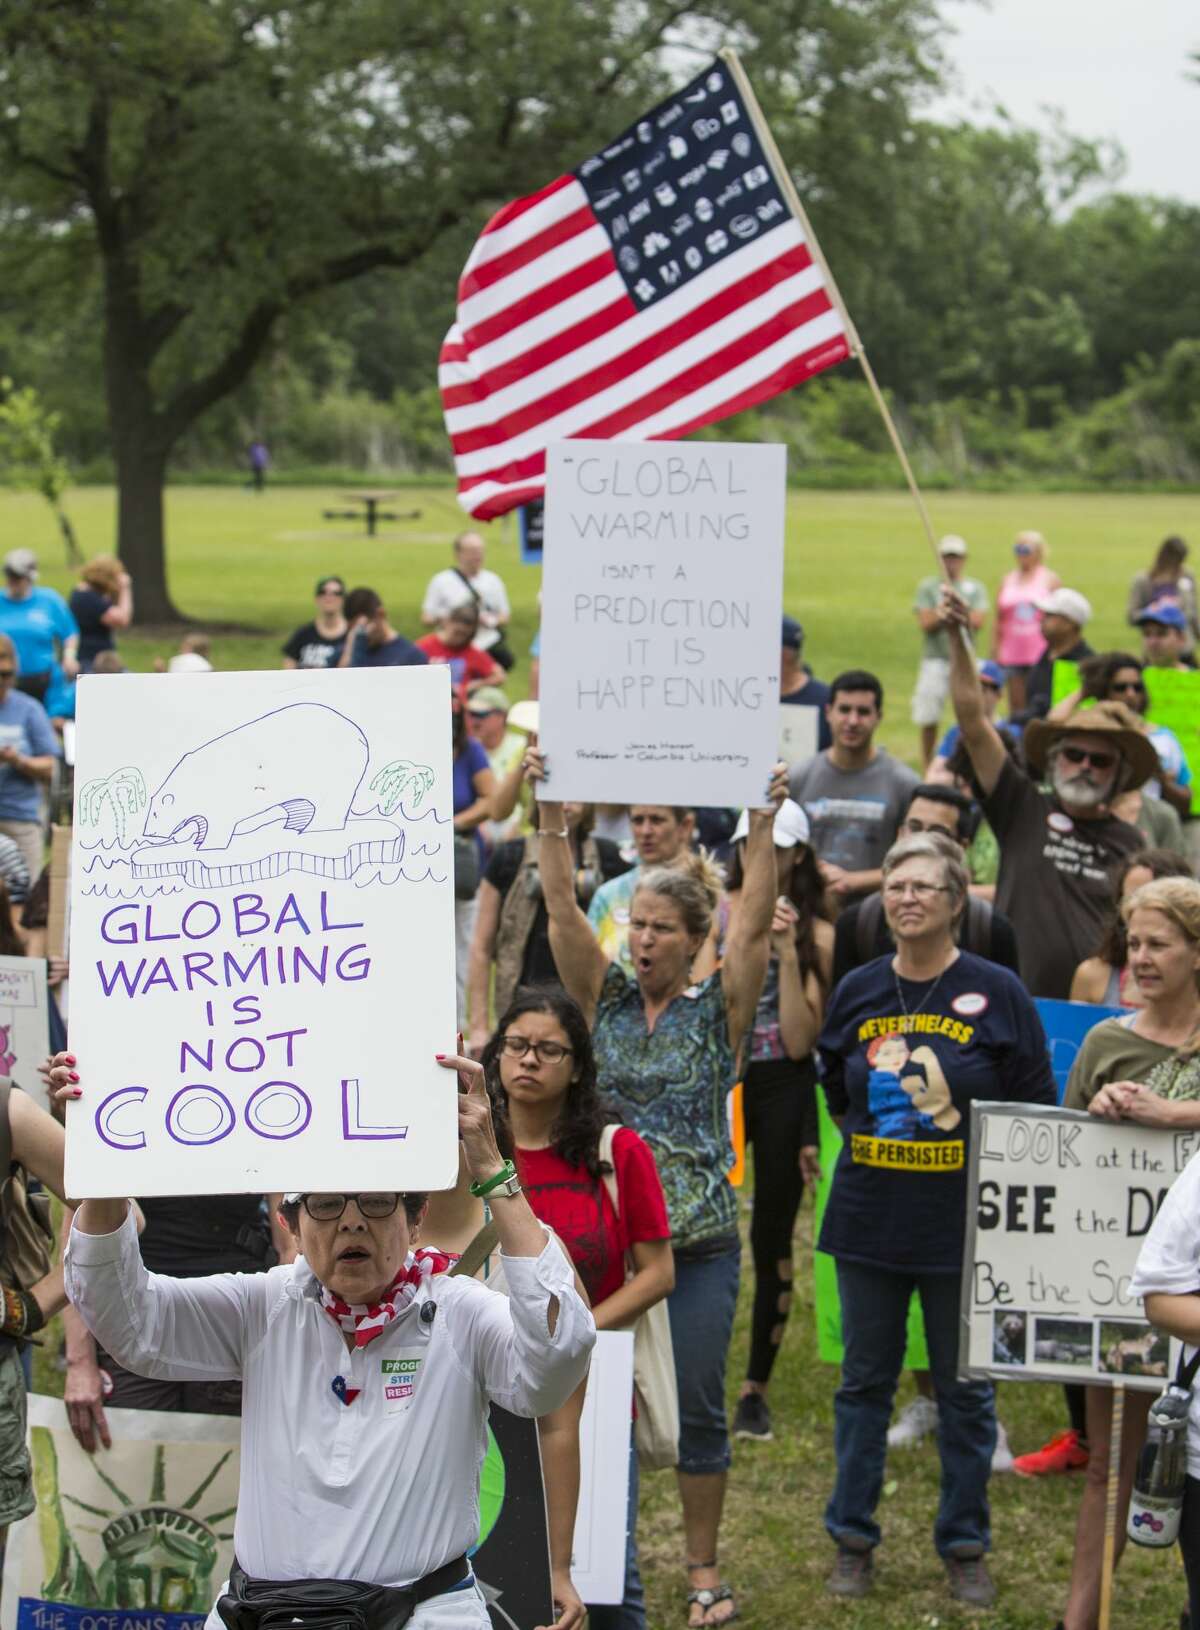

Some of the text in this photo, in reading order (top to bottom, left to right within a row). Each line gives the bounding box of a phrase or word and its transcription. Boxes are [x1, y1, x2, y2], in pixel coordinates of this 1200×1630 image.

[569, 510, 750, 541] WARMING
[602, 564, 687, 580] ISN'T A
[574, 593, 750, 629] PREDICTION
[627, 637, 706, 666] IT IS
[690, 751, 750, 767] University
[100, 890, 365, 945] GLOBAL
[96, 943, 372, 998] WARMING
[206, 995, 262, 1027] IS
[858, 1013, 975, 1045] NEVERTHELESS
[179, 1028, 308, 1074] NOT
[94, 1078, 410, 1150] COOL
[877, 1142, 960, 1166] PERSISTED
[978, 1116, 1200, 1174] LOOK at the E
[977, 1180, 1057, 1235] SEE
[1075, 1209, 1119, 1234] the
[974, 1260, 1014, 1306] Be
[1028, 1265, 1081, 1304] the
[31, 1607, 66, 1630] THE
